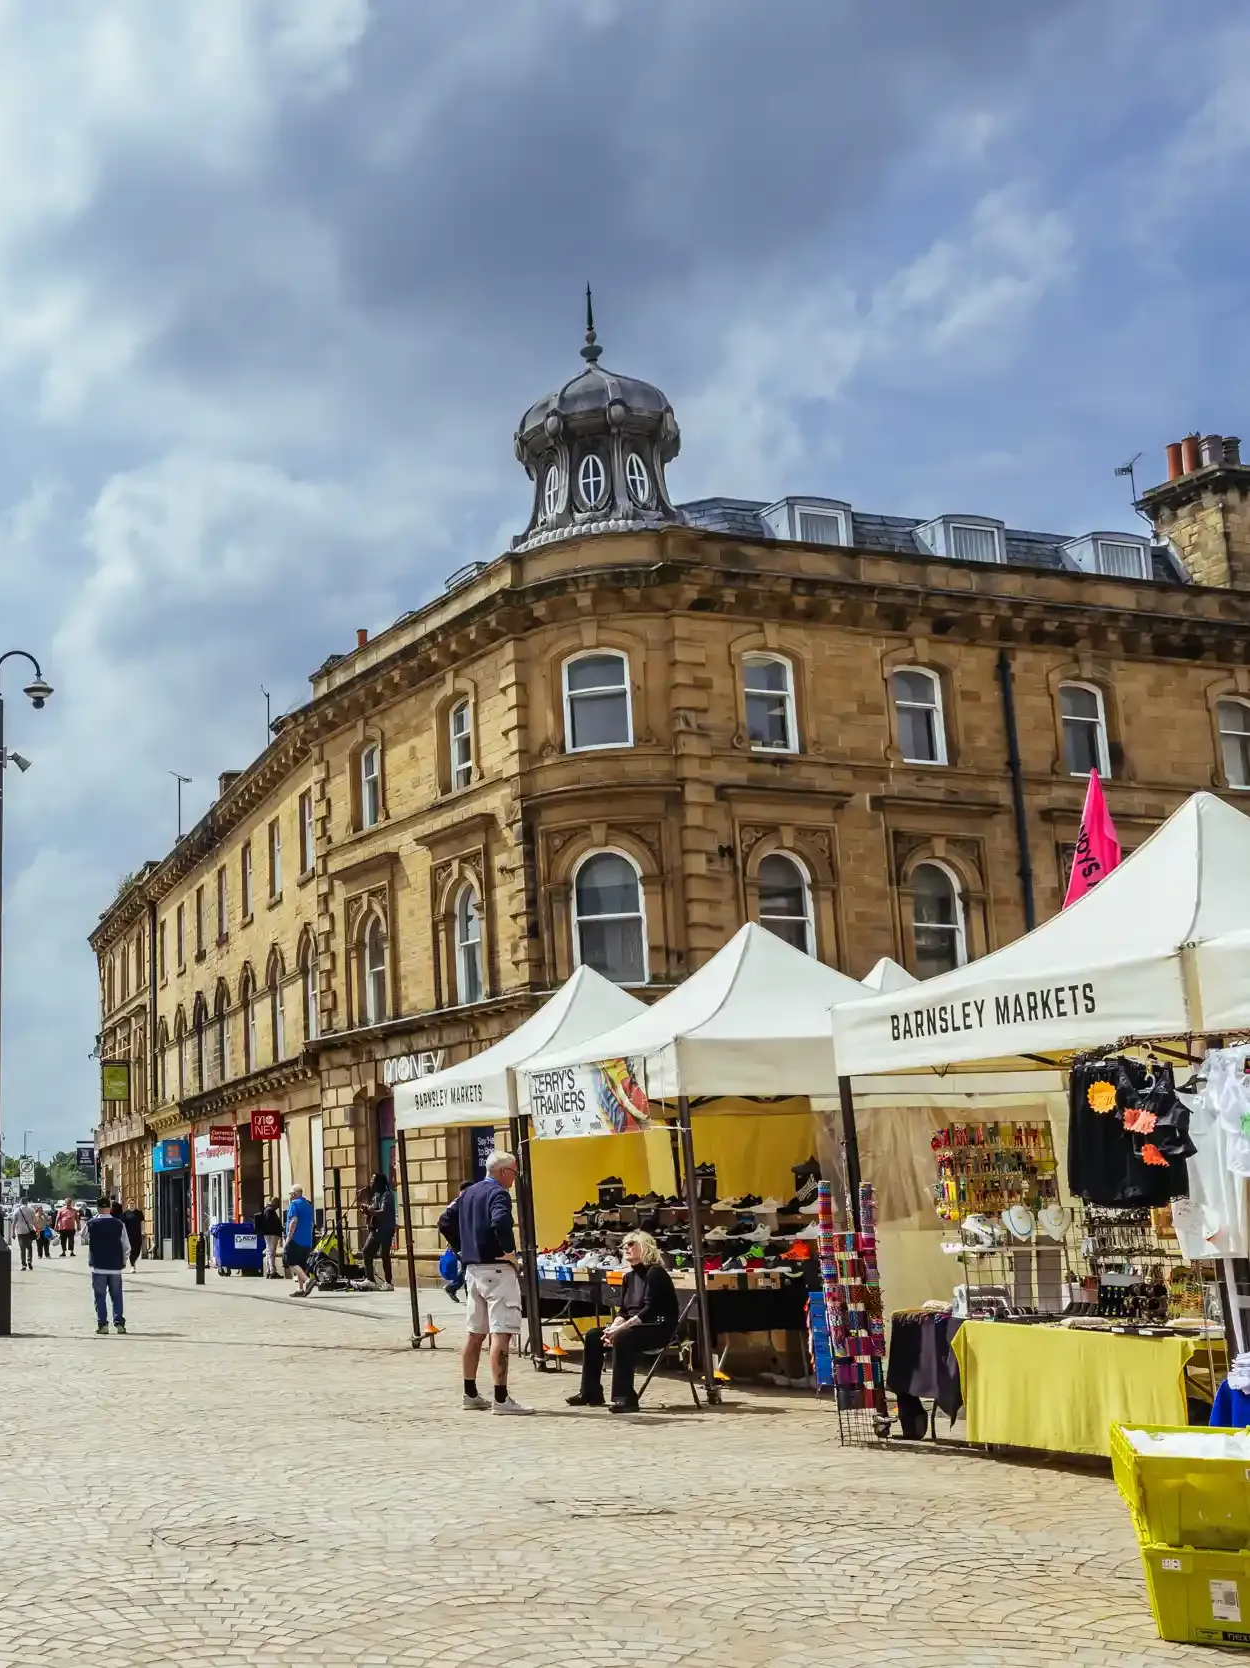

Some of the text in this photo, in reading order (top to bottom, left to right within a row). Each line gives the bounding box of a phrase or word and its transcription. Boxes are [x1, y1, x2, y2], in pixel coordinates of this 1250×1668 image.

[890, 982, 1096, 1041] BARNSLEY MARKETS
[532, 1068, 575, 1094] TERRY'S
[414, 1084, 483, 1110] BARNSLEY MARKETS
[533, 1090, 586, 1116] TRAINERS
[1228, 1633, 1250, 1641] nex
